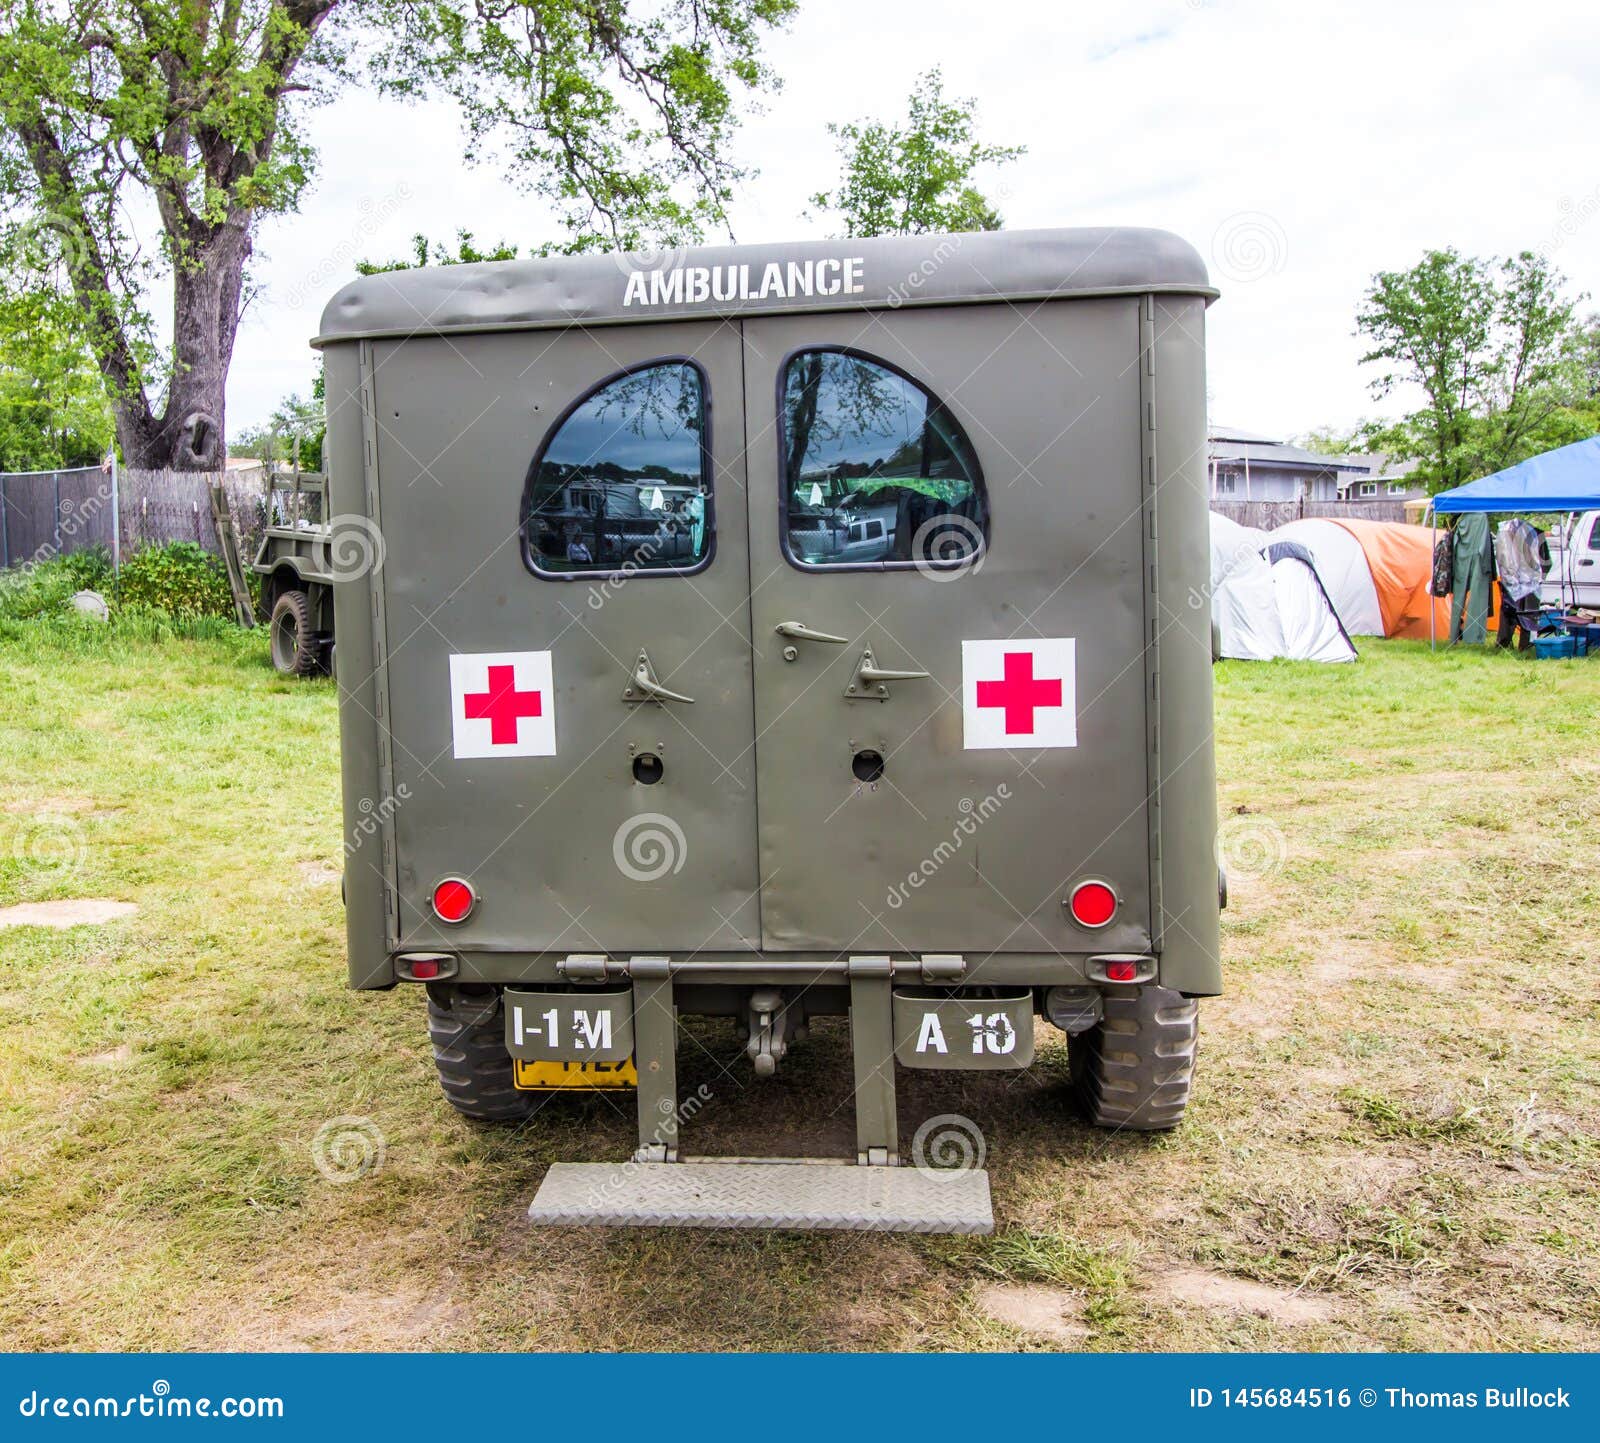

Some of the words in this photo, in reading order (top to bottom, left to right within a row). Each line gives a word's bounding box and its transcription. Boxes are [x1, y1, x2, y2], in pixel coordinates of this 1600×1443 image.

[623, 258, 864, 307] AMBULANCE
[513, 1006, 559, 1048] I-1
[572, 1010, 612, 1049] M
[915, 1012, 948, 1053] A
[965, 1012, 1016, 1054] 10
